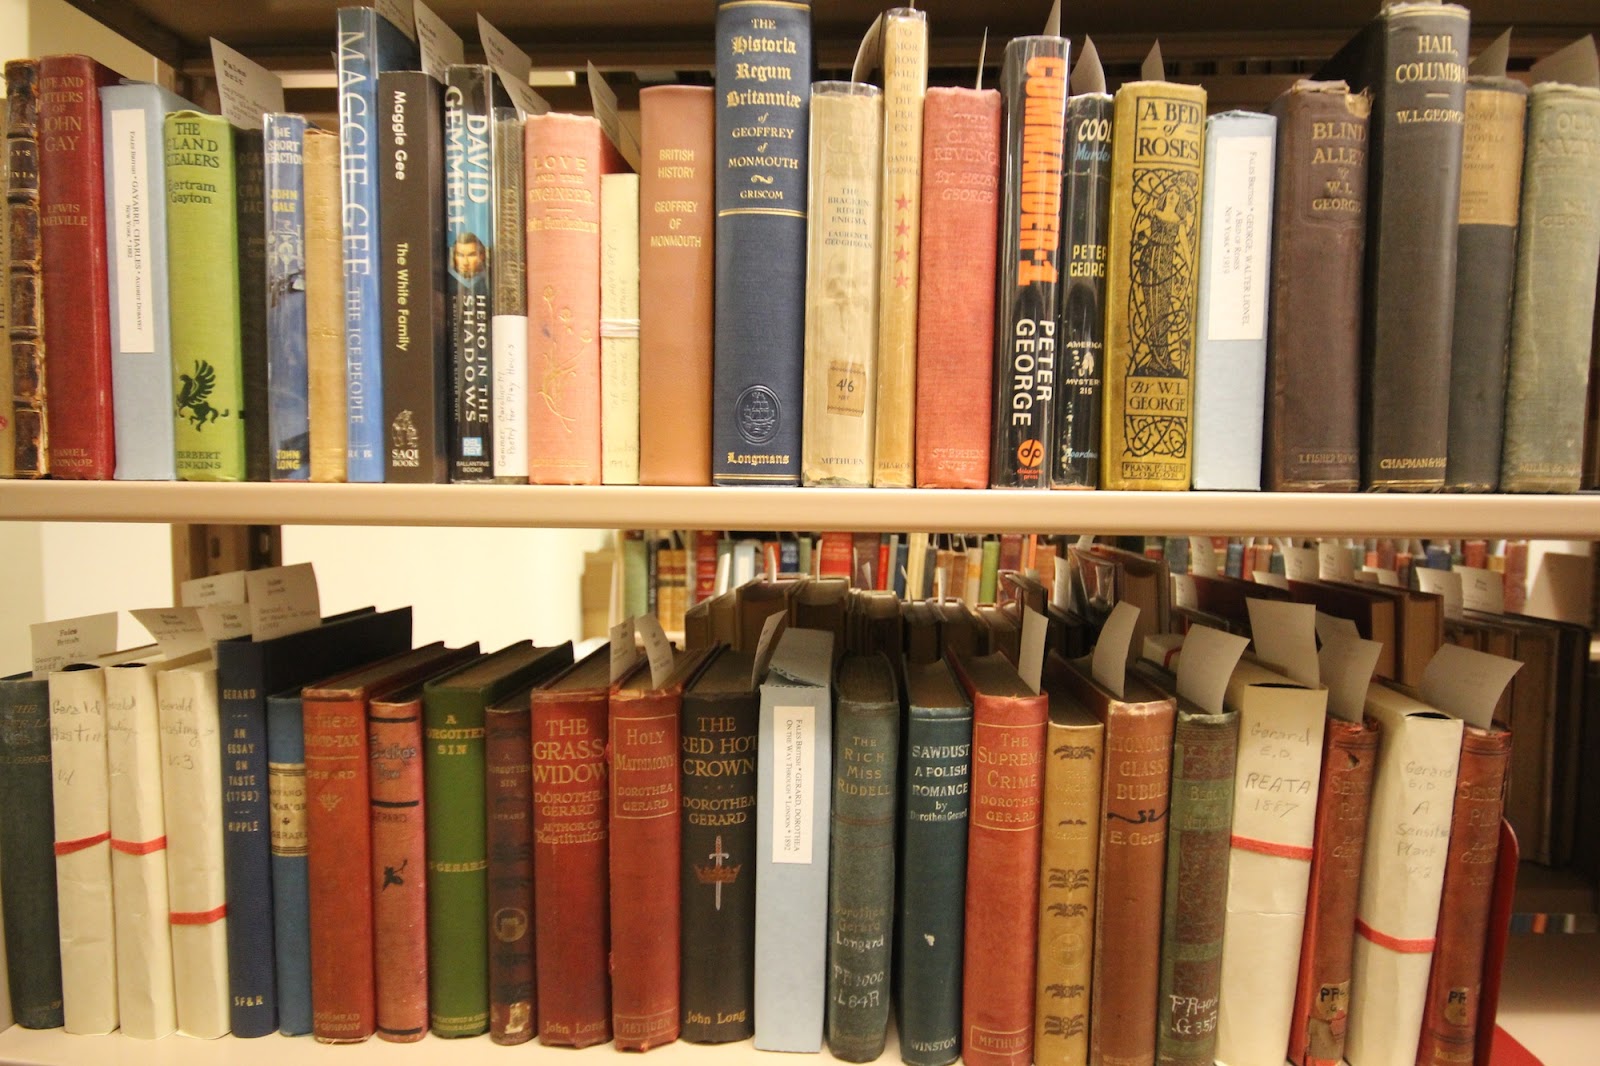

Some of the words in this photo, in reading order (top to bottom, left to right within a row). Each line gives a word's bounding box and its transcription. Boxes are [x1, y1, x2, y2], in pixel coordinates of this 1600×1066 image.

[751, 19, 776, 29] THE
[61, 77, 84, 87] AND
[52, 105, 65, 113] OF
[339, 31, 368, 185] MAGGIE
[1141, 102, 1160, 121] A
[1165, 105, 1199, 125] BED
[42, 116, 82, 133] JOHN
[392, 91, 406, 146] Maggie
[758, 112, 769, 123] of
[175, 122, 200, 135] THE
[271, 126, 291, 138] THE
[732, 127, 794, 139] GEOFFREY
[1078, 119, 1112, 142] COOL
[1163, 122, 1179, 136] of
[1312, 122, 1366, 140] BLIND
[45, 136, 79, 152] GAY
[267, 140, 299, 151] SHORT
[758, 142, 769, 154] of
[1139, 137, 1199, 160] ROSES
[444, 85, 465, 232] GEMMELL
[466, 113, 489, 204] DAVID
[659, 149, 695, 161] BRITISH
[394, 150, 408, 181] Gee
[533, 156, 587, 171] LOVE
[728, 157, 799, 169] MONMOUTH
[657, 167, 695, 179] HISTORY
[170, 191, 213, 205] Gayton
[271, 190, 297, 200] JOHN
[740, 190, 783, 199] GRISCOM
[271, 202, 296, 213] GALE
[654, 201, 698, 213] GEOFFREY
[669, 218, 682, 229] OF
[342, 203, 371, 276] GEE
[650, 236, 701, 247] MONMOUTH
[396, 242, 408, 266] The
[396, 269, 409, 305] White
[475, 294, 488, 349] HERO
[397, 309, 409, 351] Family
[463, 294, 477, 423] SHADOWS
[477, 354, 488, 377] IN
[1036, 320, 1055, 401] PETER
[1012, 318, 1036, 426] GEORGE
[478, 384, 489, 424] THE
[1130, 396, 1186, 412] GEORGE
[275, 450, 300, 460] JOHN
[392, 449, 419, 460] SAQI
[726, 452, 790, 467] Longmans
[276, 460, 300, 470] LONG
[445, 715, 457, 724] A
[697, 716, 736, 733] THE
[546, 718, 589, 737] THE
[853, 736, 877, 747] THE
[1000, 733, 1029, 747] THE
[227, 744, 254, 754] ESSAY
[437, 745, 467, 755] SIN
[533, 739, 605, 761] GRASS
[844, 748, 885, 763] RICH
[912, 744, 970, 758] SAWDUST
[533, 762, 607, 785] WIDOW
[683, 758, 754, 777] CROWN
[846, 765, 882, 780] MISS
[914, 766, 923, 777] A
[926, 765, 967, 778] POLISH
[228, 775, 255, 786] TASTE
[837, 779, 890, 796] RIDDELL
[987, 770, 1037, 790] CRIME
[1245, 772, 1311, 796] REATA
[617, 783, 673, 796] DOROTHEA
[912, 782, 968, 797] ROMANCE
[542, 805, 597, 817] GERARD
[622, 799, 669, 812] GERARD
[935, 800, 948, 812] by
[689, 812, 747, 826] GERARD
[986, 811, 1035, 823] GERARD
[794, 808, 802, 852] DOROTHEA
[836, 930, 884, 953] Longard
[686, 1010, 711, 1025] John
[717, 1009, 747, 1024] Long
[911, 1036, 957, 1051] WINSTON
